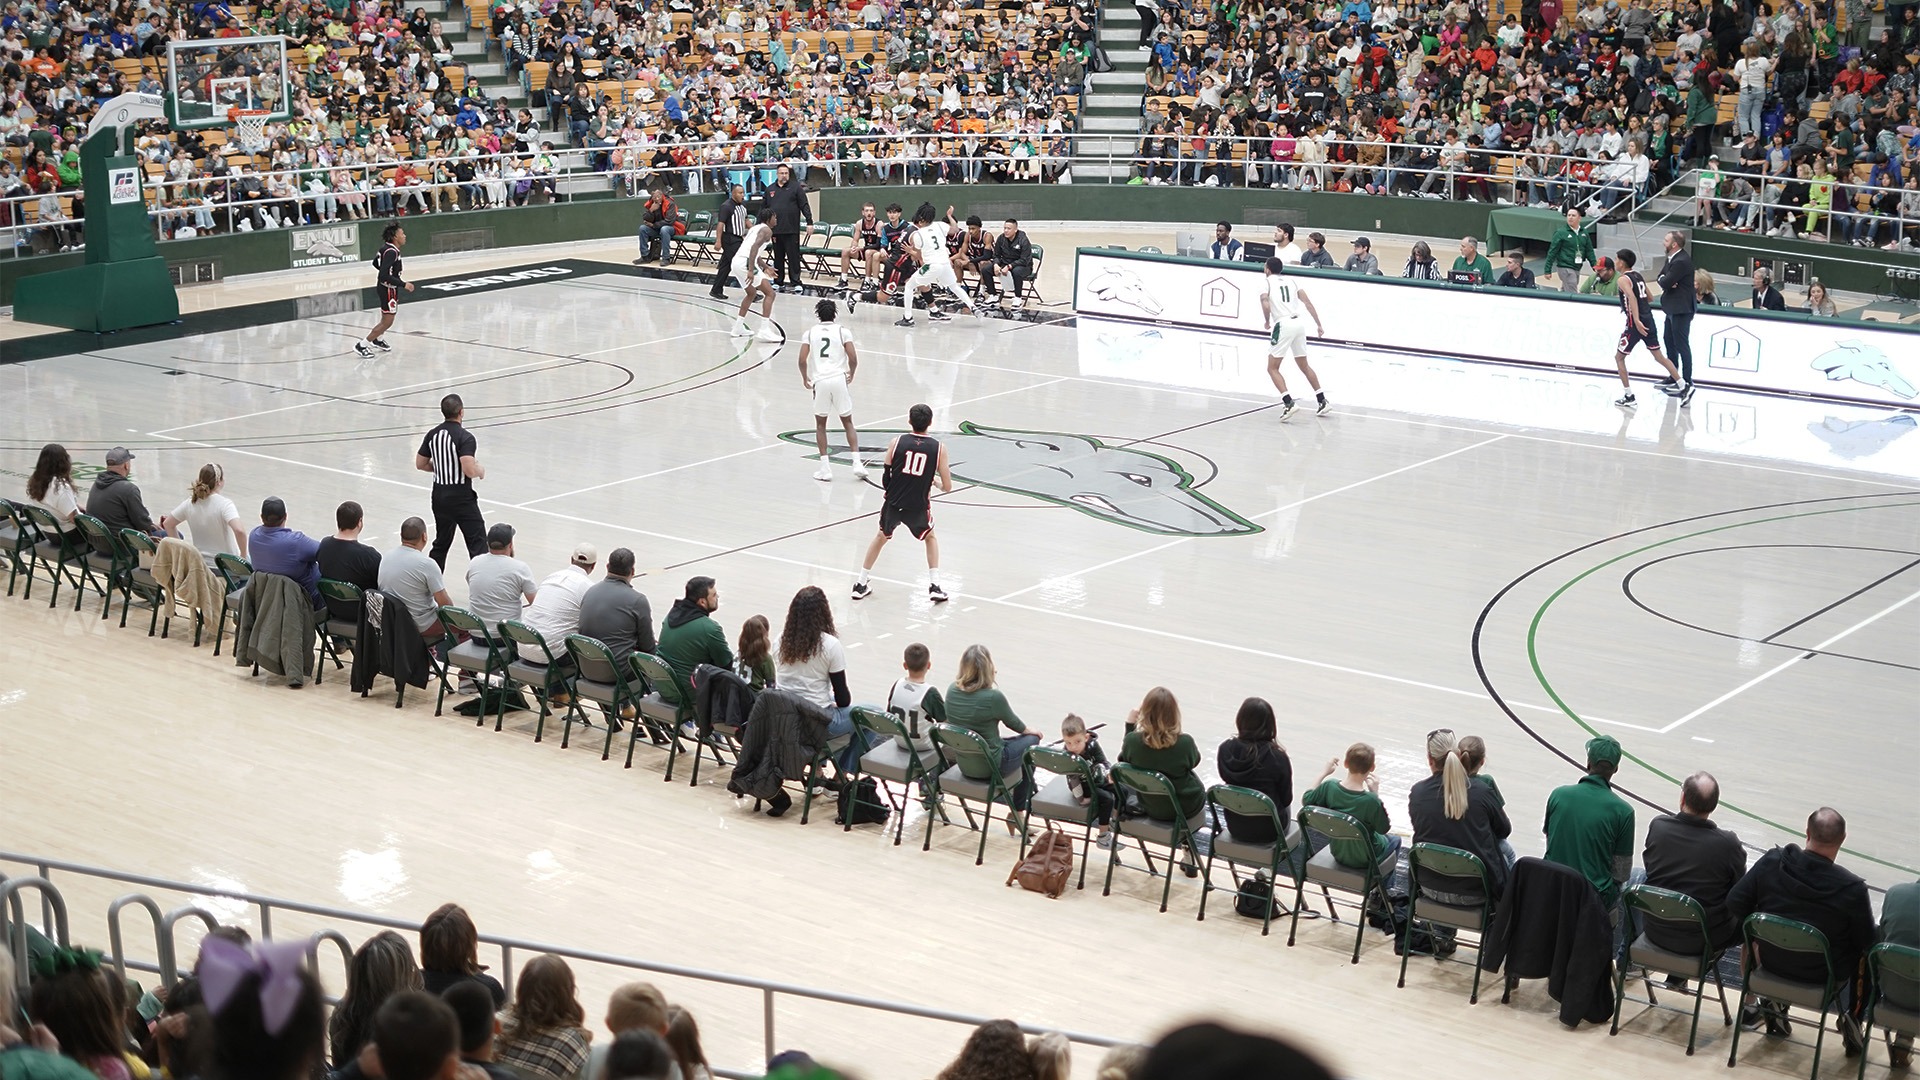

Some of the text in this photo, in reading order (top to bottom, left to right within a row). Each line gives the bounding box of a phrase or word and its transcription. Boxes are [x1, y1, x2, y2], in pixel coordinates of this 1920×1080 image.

[112, 190, 138, 200] AGENCY
[292, 225, 357, 251] ENMU
[930, 236, 940, 251] 3
[293, 257, 326, 268] STUDENT
[421, 266, 573, 292] ENMU
[1279, 285, 1291, 303] 11
[1636, 281, 1648, 299] 12
[819, 337, 831, 358] 2
[902, 450, 928, 477] 10
